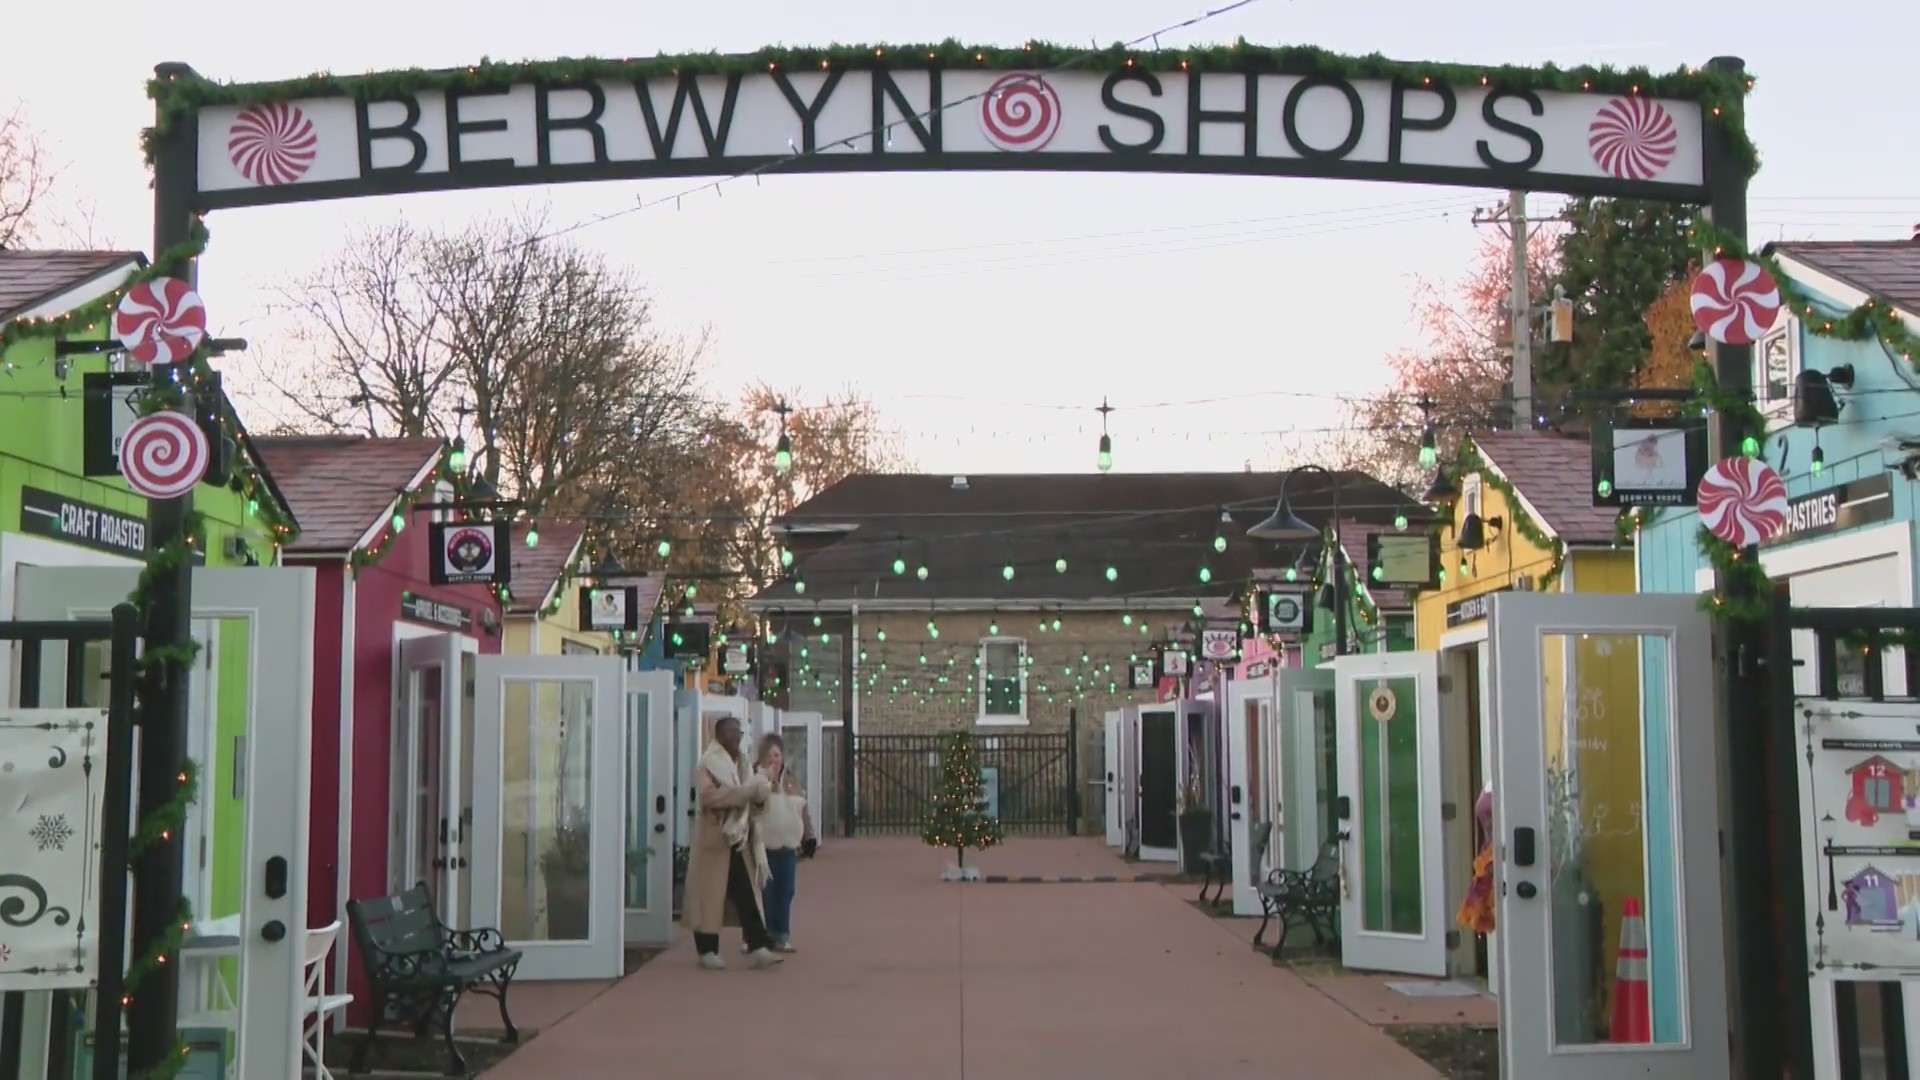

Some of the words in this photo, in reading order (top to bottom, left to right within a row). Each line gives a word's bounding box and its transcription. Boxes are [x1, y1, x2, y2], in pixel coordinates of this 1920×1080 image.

[355, 72, 943, 172] BERWYN
[1097, 68, 1543, 171] SHOPS
[1777, 434, 1790, 475] 2
[61, 503, 98, 541] CRAFT
[101, 513, 145, 551] ROASTED
[1786, 493, 1836, 534] PASTRIES
[1868, 764, 1887, 777] 12
[1864, 874, 1879, 888] 11
